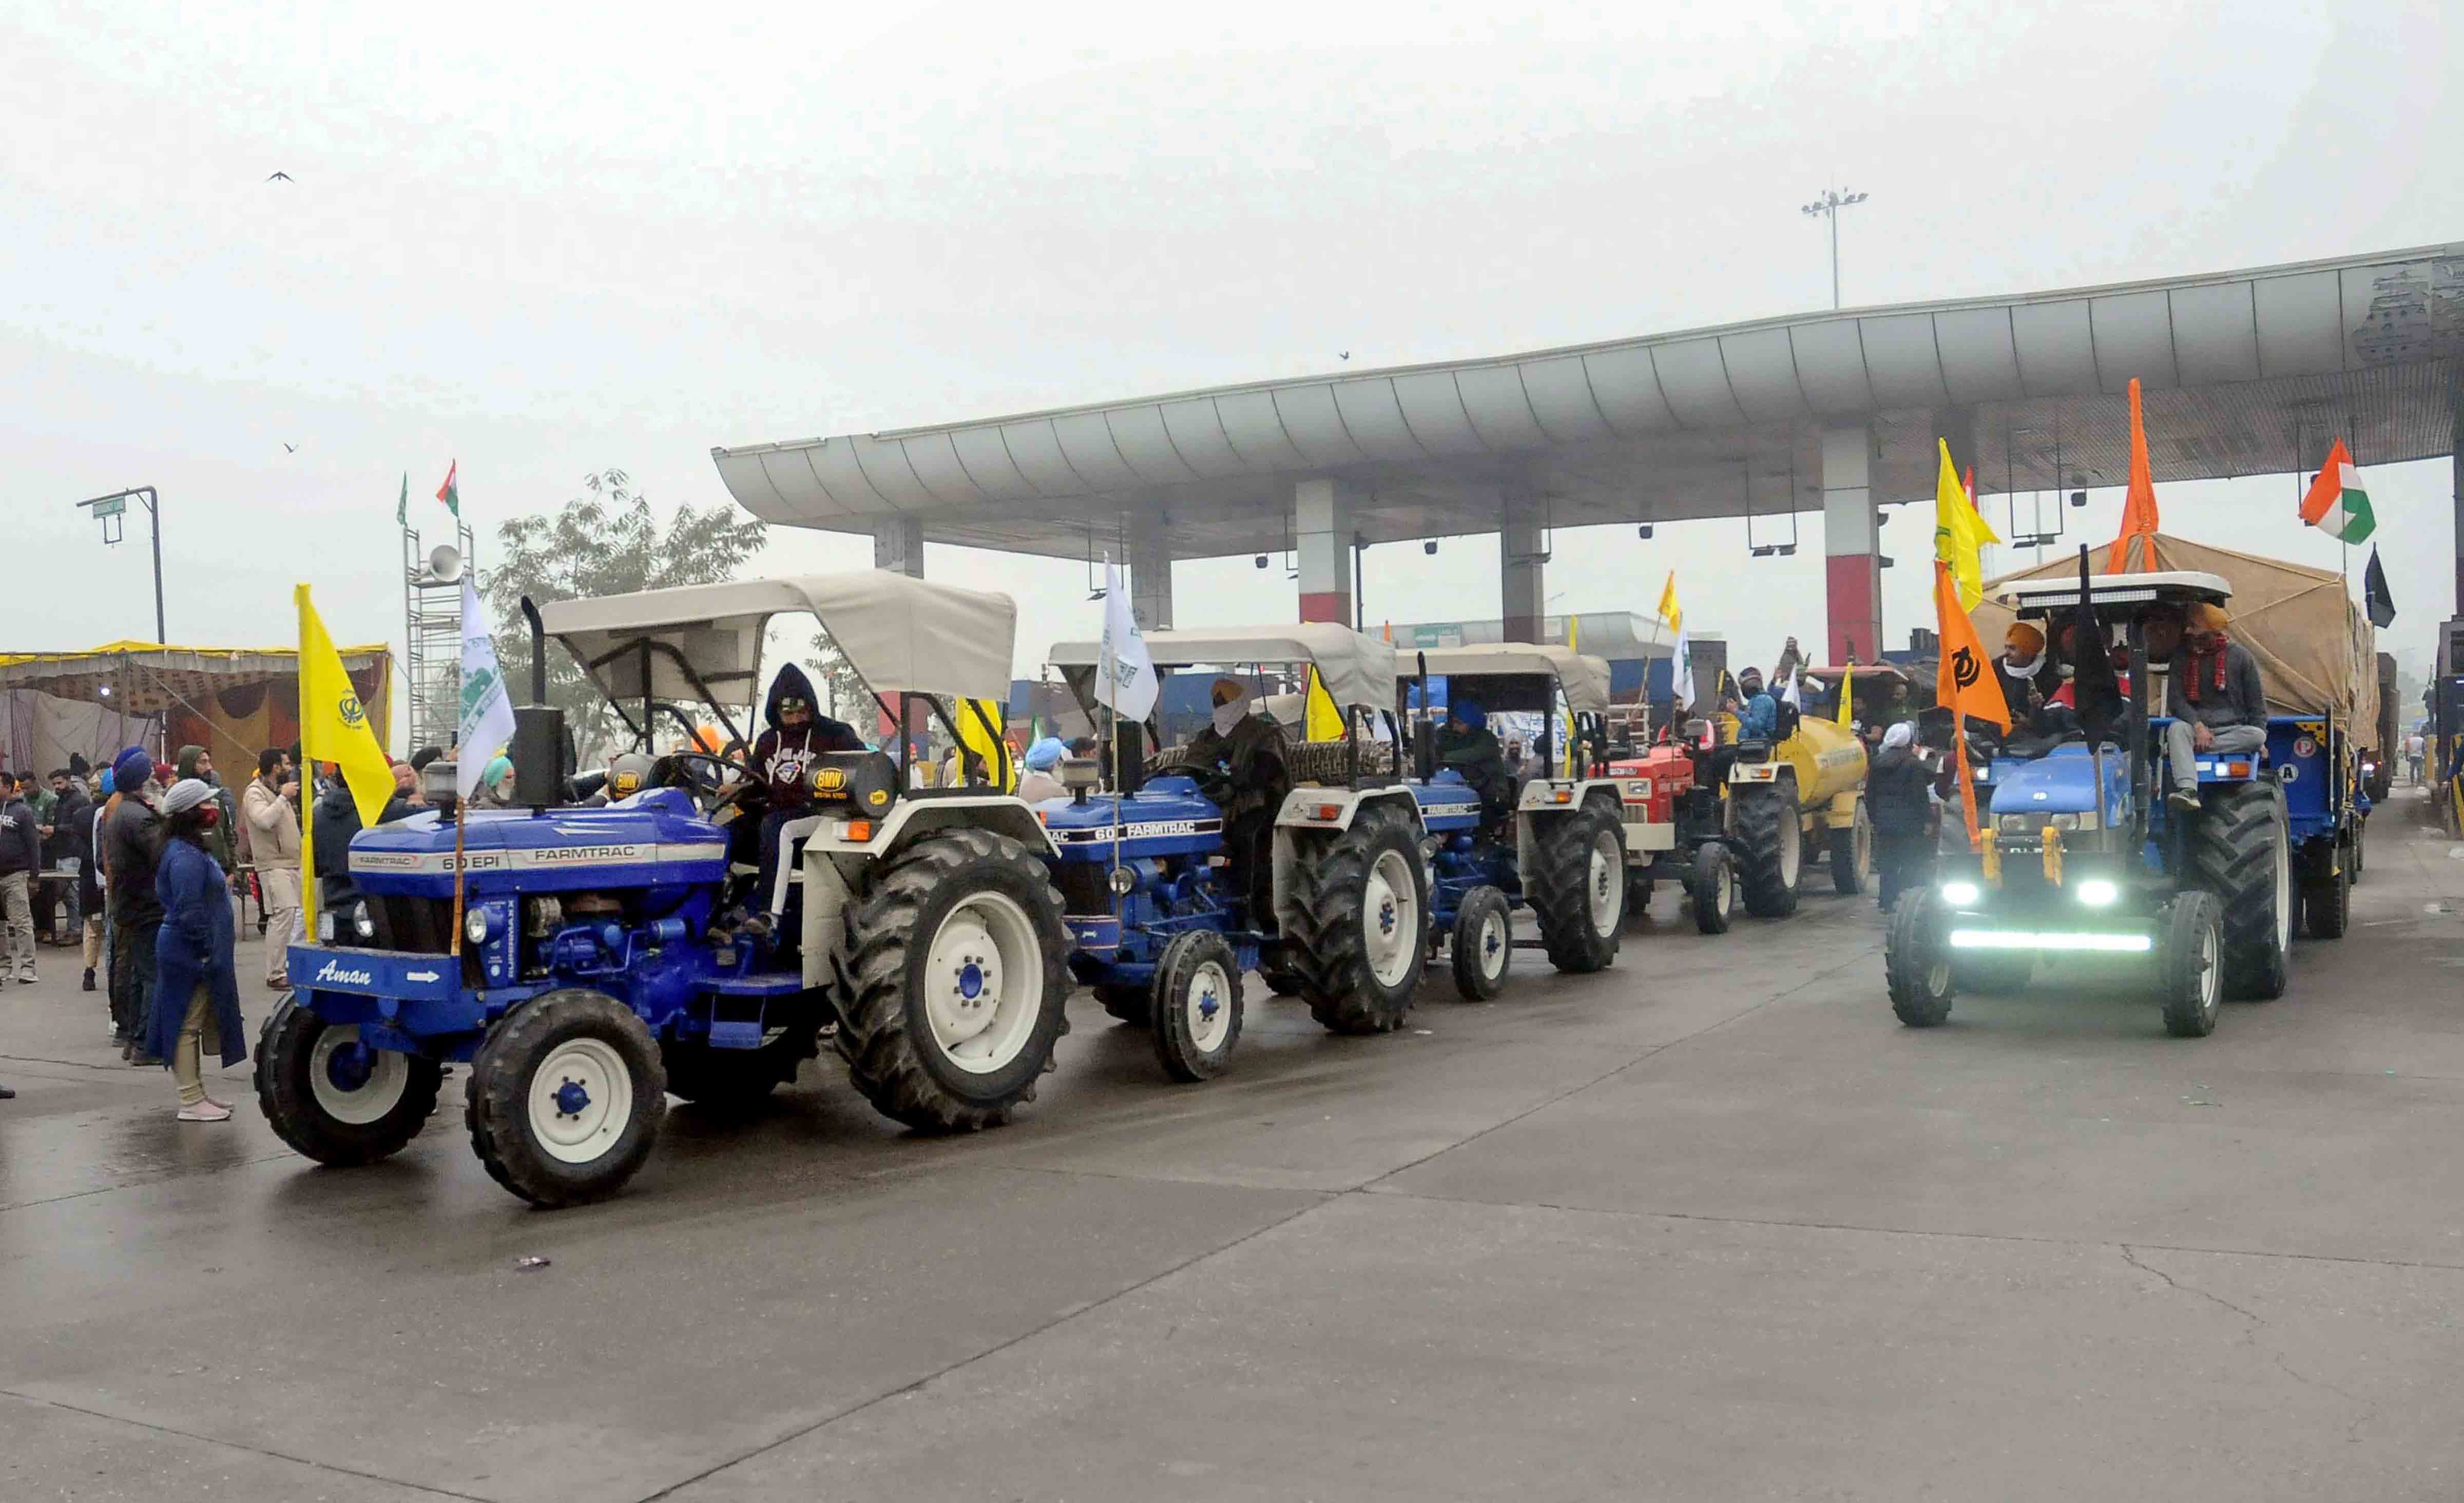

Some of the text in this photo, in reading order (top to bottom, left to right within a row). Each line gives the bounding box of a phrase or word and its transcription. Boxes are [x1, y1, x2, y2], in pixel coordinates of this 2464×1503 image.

[818, 772, 842, 787] BMW
[2283, 767, 2293, 779] A
[1095, 821, 1196, 840] 60 FARMTRAC
[535, 846, 635, 860] FARMTRAC
[472, 856, 498, 868] EPI
[316, 958, 372, 985] Aman
